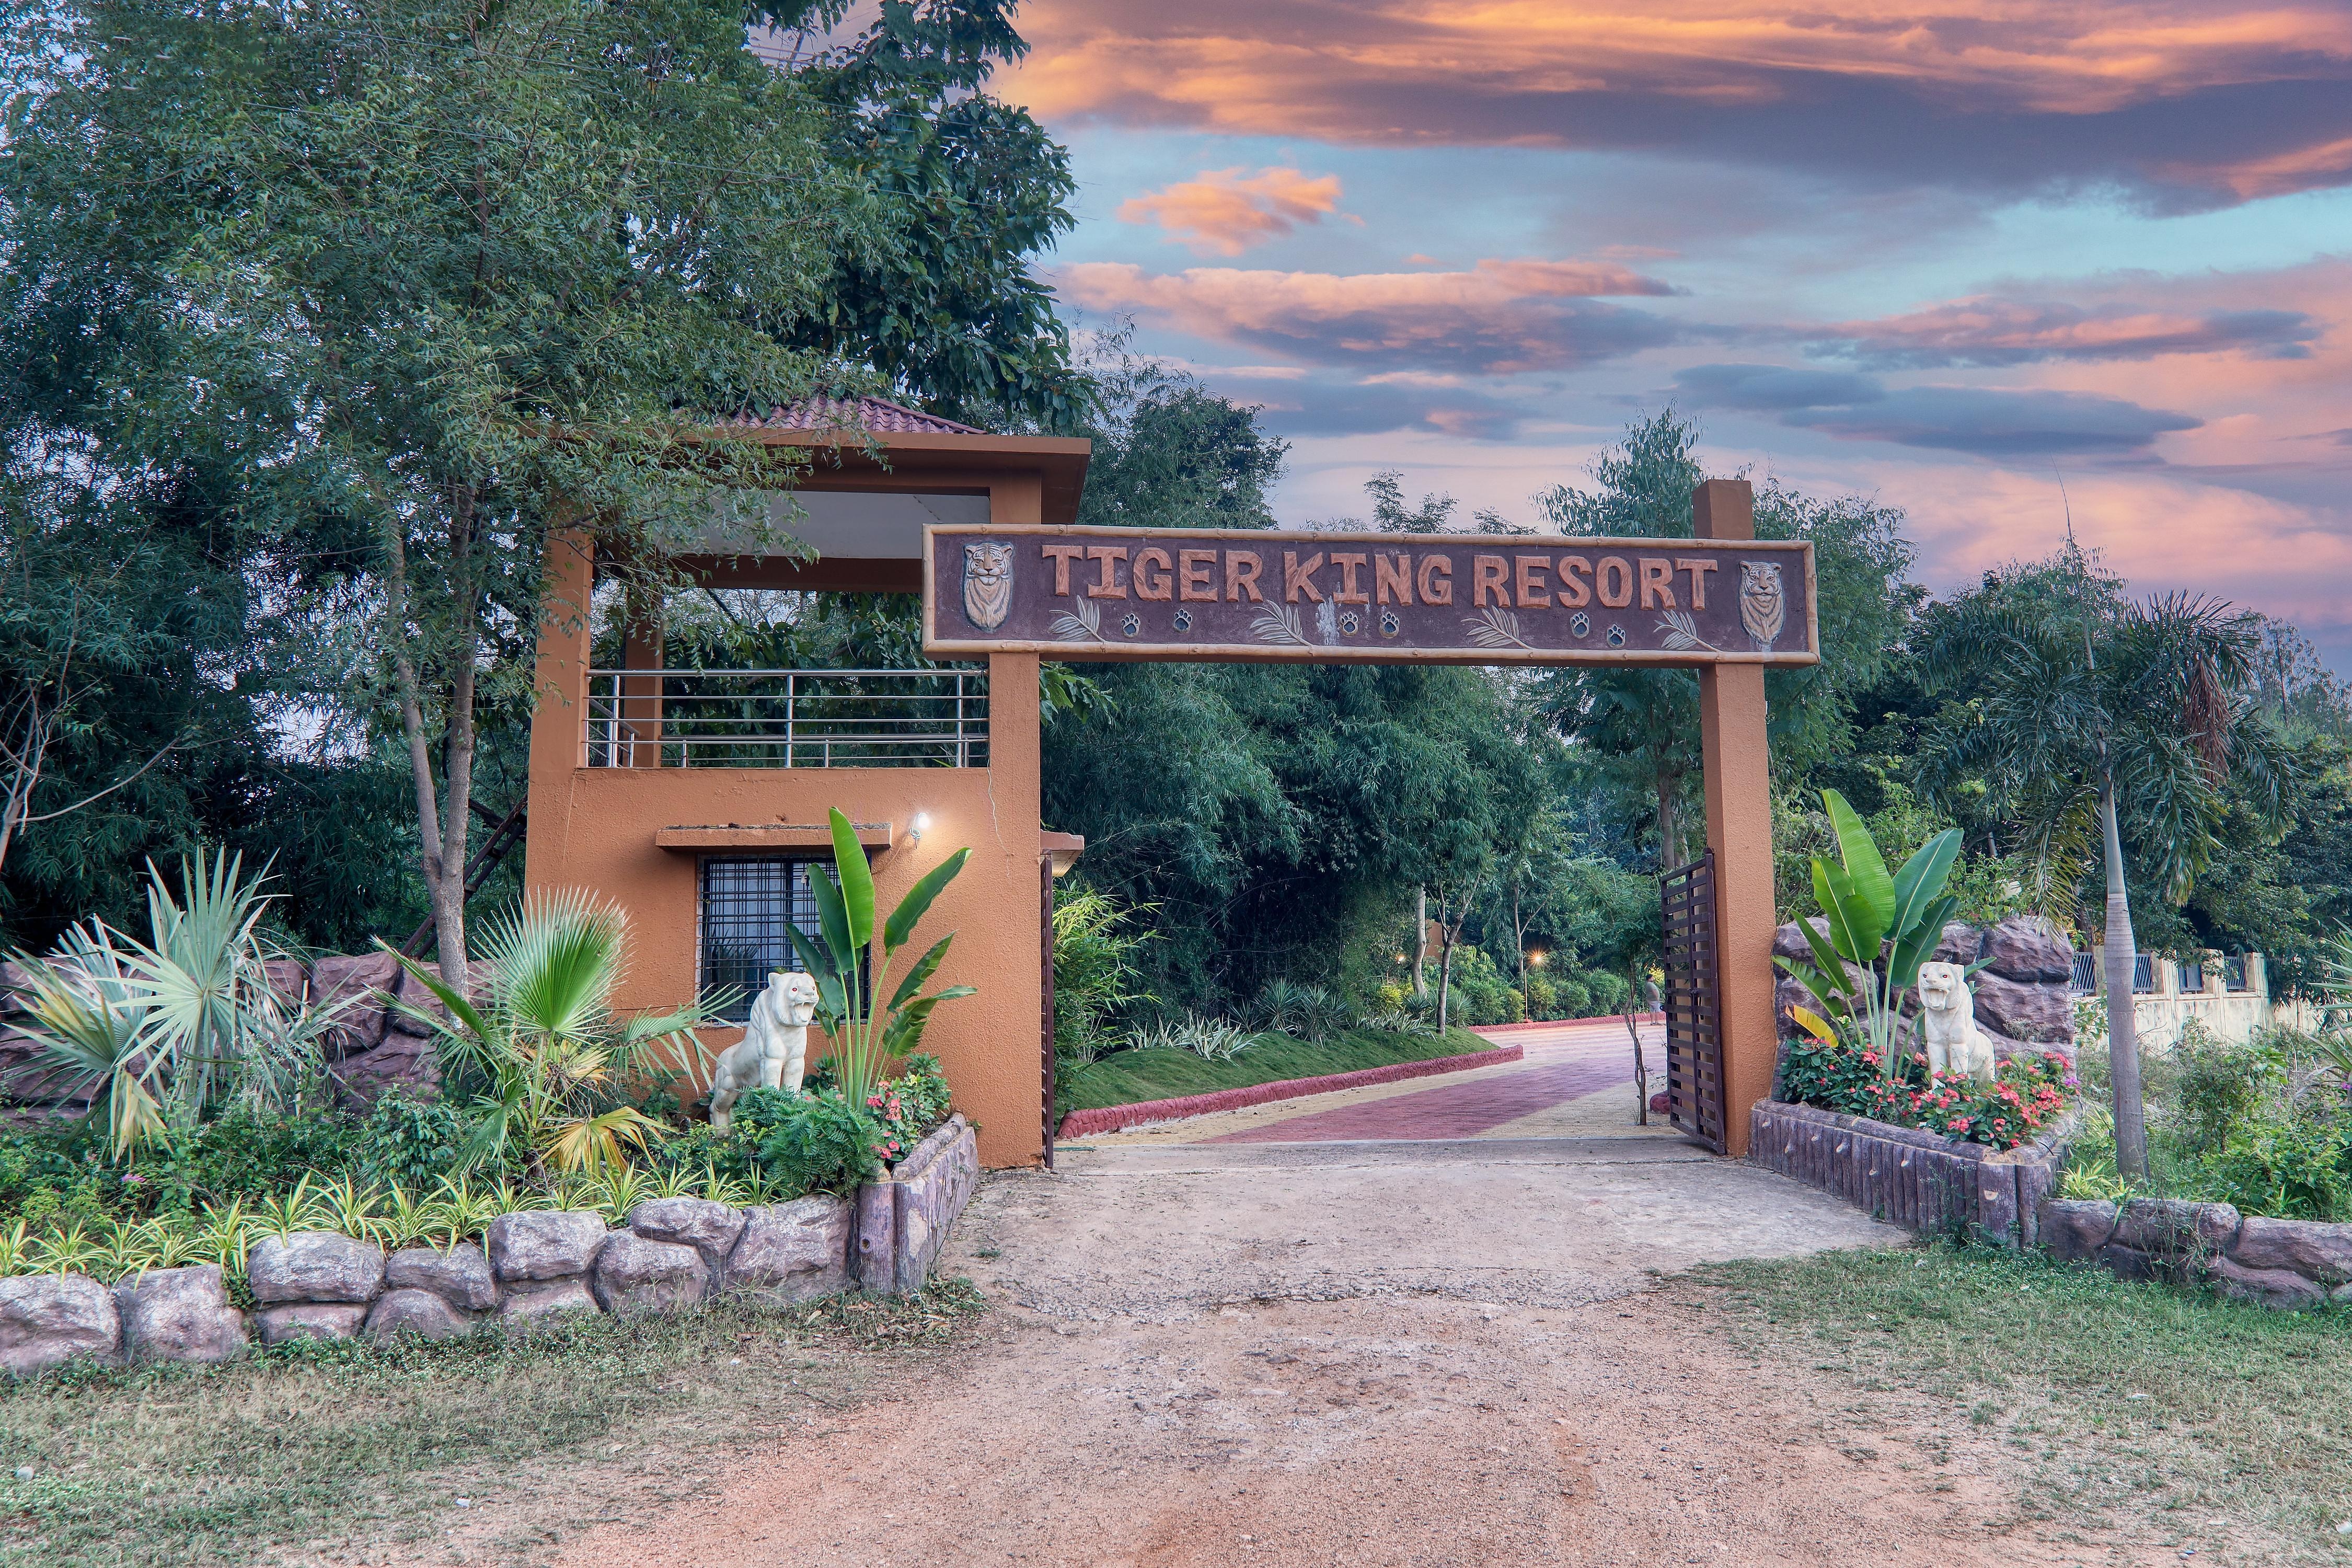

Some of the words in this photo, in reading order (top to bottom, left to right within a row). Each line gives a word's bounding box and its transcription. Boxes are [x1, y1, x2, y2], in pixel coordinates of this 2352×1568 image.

[1042, 545, 1263, 602] TIGER
[1283, 551, 1452, 606] KING
[1473, 555, 1718, 610] RESORT
